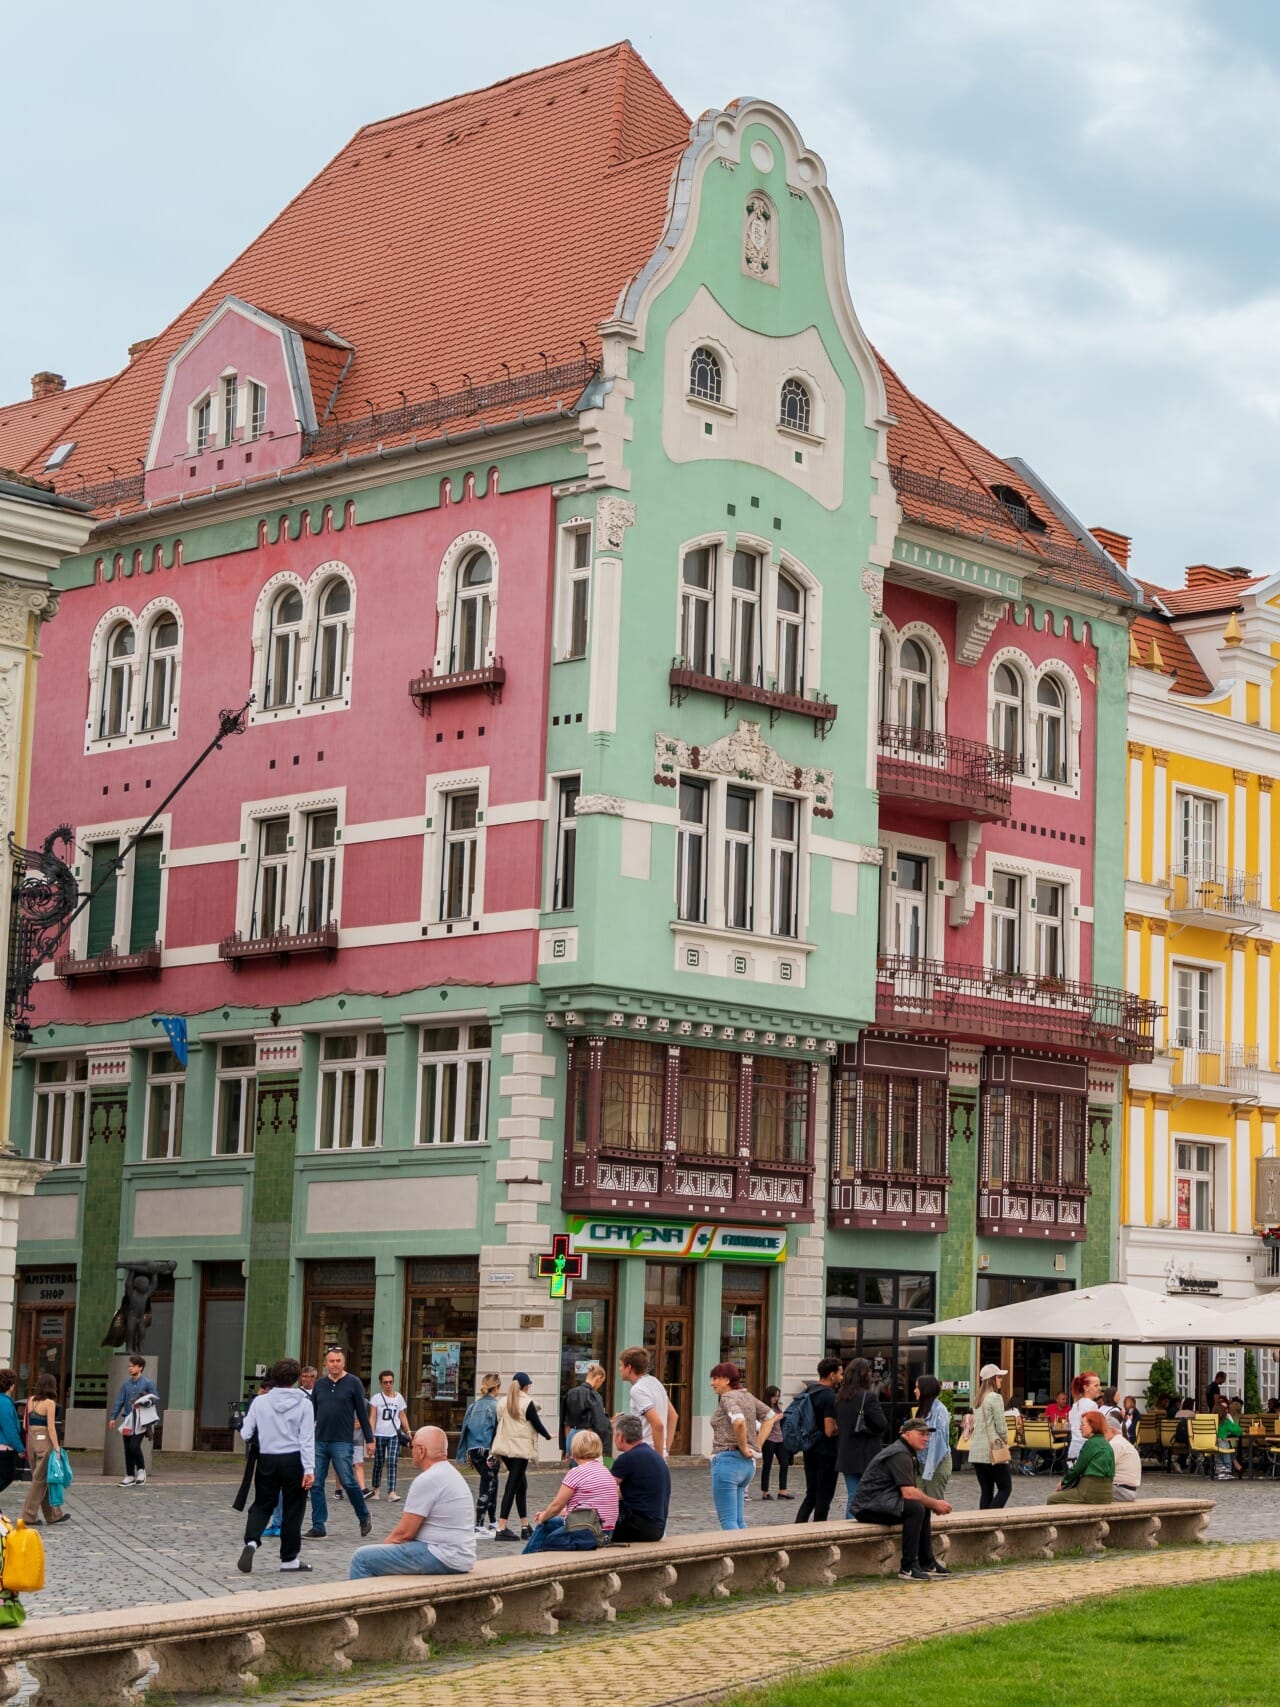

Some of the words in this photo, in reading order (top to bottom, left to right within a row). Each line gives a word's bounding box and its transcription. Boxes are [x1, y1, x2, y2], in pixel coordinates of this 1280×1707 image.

[589, 1223, 684, 1243] CATENA
[721, 1234, 780, 1249] FARMACIE
[40, 1289, 64, 1299] SHOP
